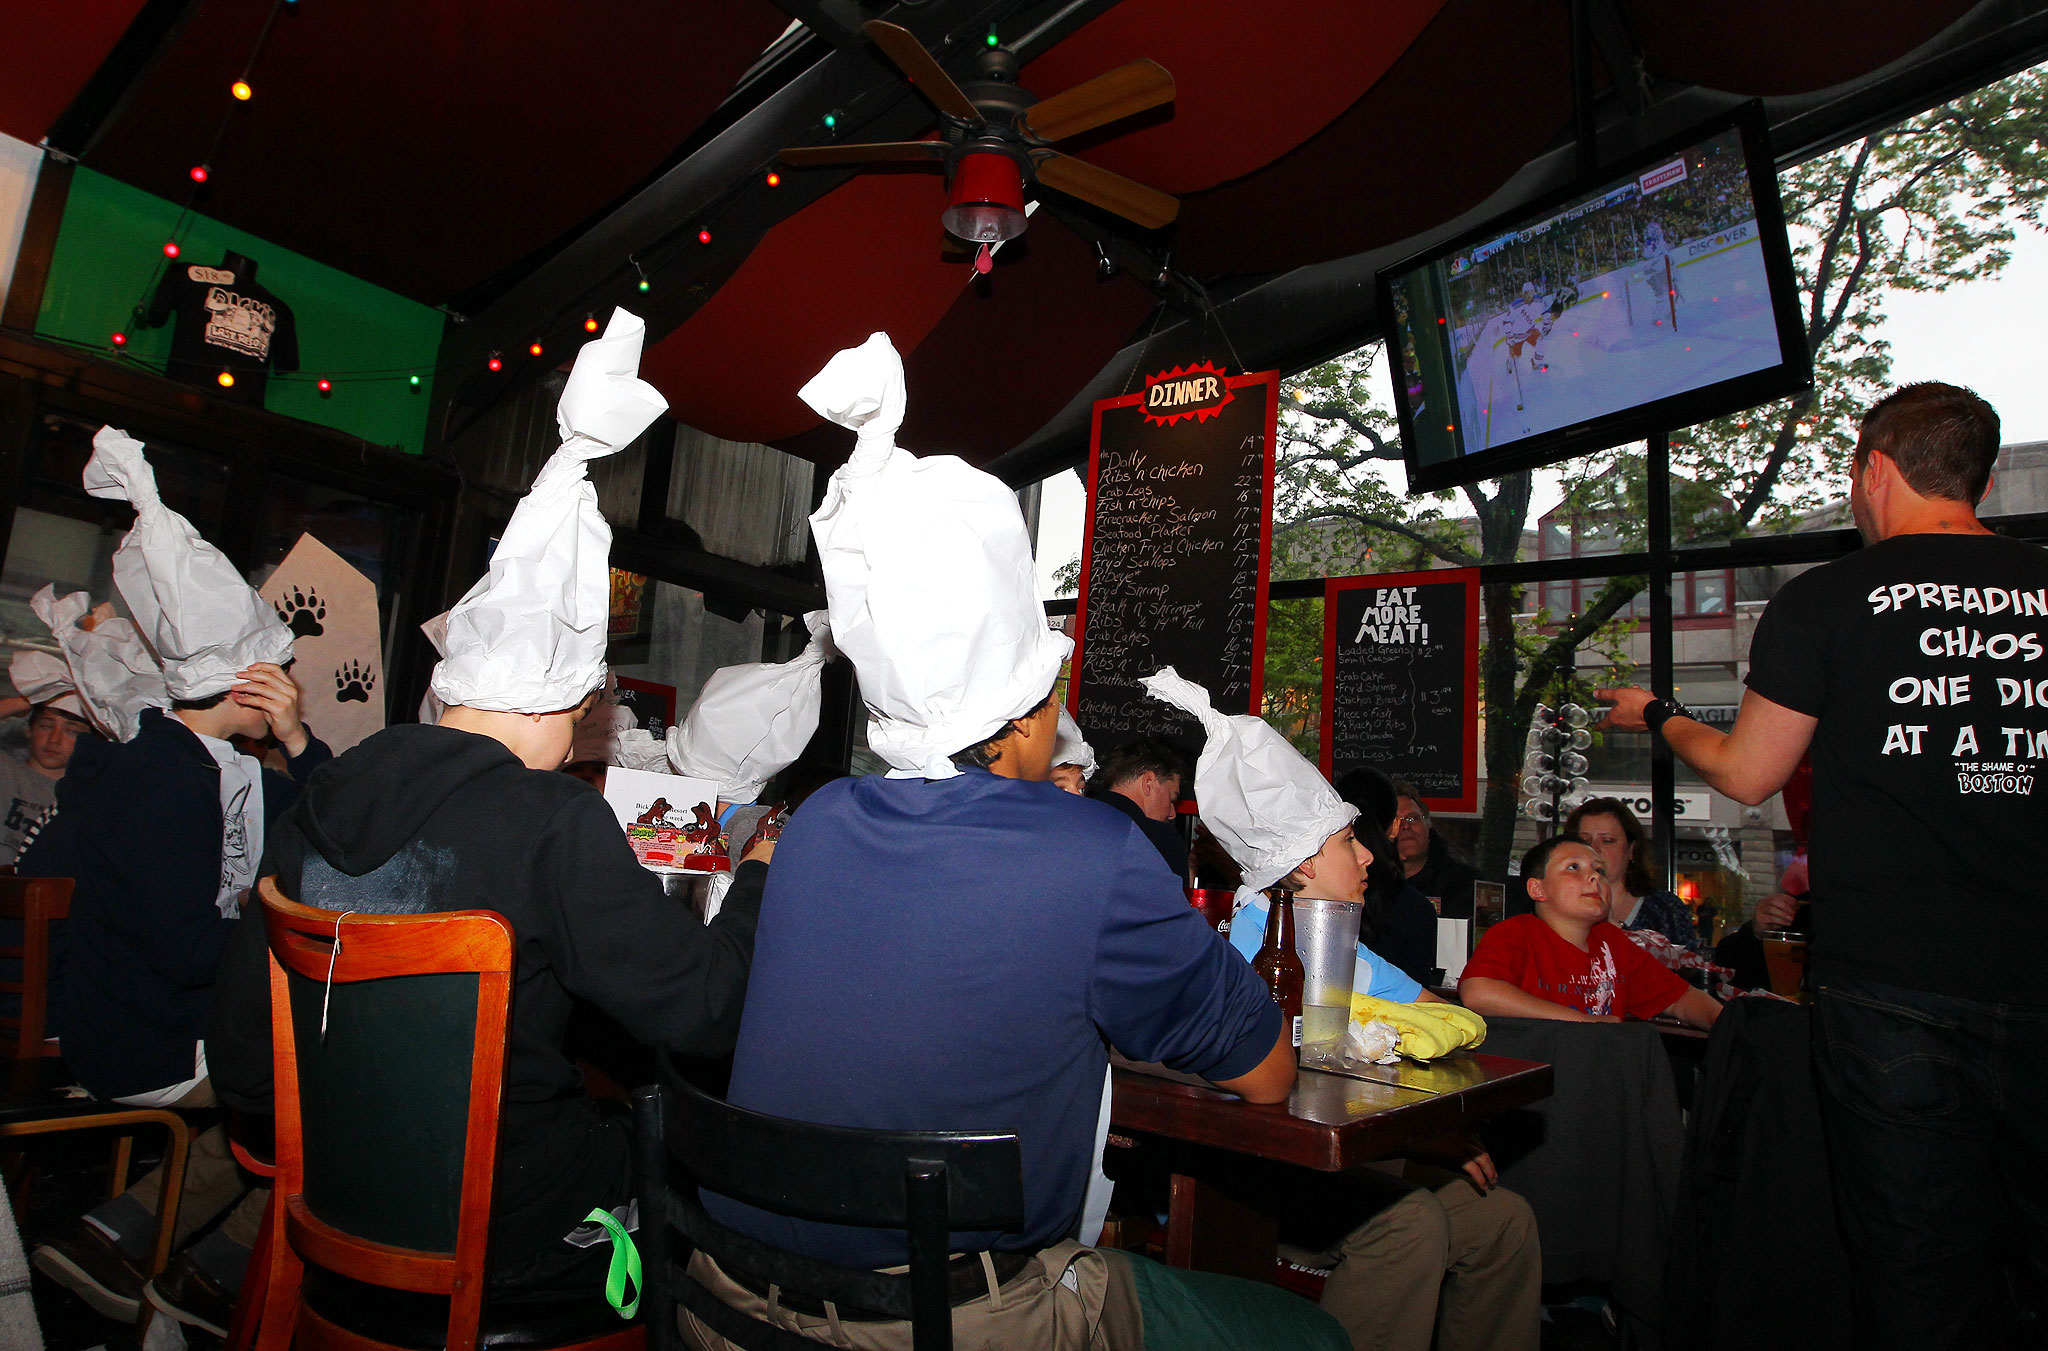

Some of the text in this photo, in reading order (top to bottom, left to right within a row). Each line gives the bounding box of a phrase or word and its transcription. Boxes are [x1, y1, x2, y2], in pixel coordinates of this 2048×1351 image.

[1488, 244, 1505, 256] NYR
[1535, 224, 1552, 235] BOS
[1569, 210, 1584, 221] 2nd
[1688, 227, 1747, 257] DISCOVER
[1149, 376, 1220, 407] DINNER
[1109, 450, 1147, 471] Dolly
[1099, 469, 1131, 484] Ribs
[1098, 484, 1123, 499] Crab
[1126, 484, 1153, 501] Legs
[1096, 498, 1122, 511] Fish
[1096, 512, 1160, 526] Firecracker
[1167, 506, 1217, 524] Salmon
[1094, 525, 1142, 539] Seafood
[1150, 523, 1194, 538] Platter
[1093, 539, 1136, 555] Chicken
[1176, 538, 1224, 554] Chicken
[1127, 555, 1177, 570] Scallops
[1125, 583, 1170, 601] Shrimp
[1375, 586, 1417, 607] EAT
[1867, 582, 2048, 616] SPREADIN
[1087, 597, 1128, 614] Steak
[1088, 613, 1122, 628] Ribs
[1182, 615, 1206, 630] Full
[1361, 605, 1422, 626] MORE
[1085, 627, 1110, 641] Crab
[1113, 628, 1150, 647] Cakes
[1355, 623, 1429, 645] MEAT!
[1085, 643, 1128, 657] Lobster
[1338, 645, 1375, 656] Loaded
[1378, 645, 1410, 655] Greens
[1919, 625, 2044, 662] CHAOS
[1083, 654, 1114, 670] Ribs
[1138, 653, 1174, 671] Win
[1338, 654, 1400, 665] Small Caesar
[1360, 671, 1386, 683] Cake
[1366, 683, 1397, 694] Shrimp
[1888, 675, 1971, 707] ONE
[1374, 689, 1408, 706] Breast
[1079, 698, 1116, 718] Chicken
[1371, 707, 1392, 719] Fish
[1431, 706, 1452, 715] each
[1089, 716, 1130, 733] Baked
[1137, 720, 1184, 737] Chicken
[1349, 720, 1371, 732] Rack
[1385, 719, 1406, 731] Ribs
[1881, 723, 1929, 756] AT
[1951, 724, 1980, 757] A
[1334, 749, 1359, 760] Crab
[1362, 749, 1393, 761] Legs
[1981, 762, 2014, 772] SHAME
[1957, 773, 2035, 796] BOSTON
